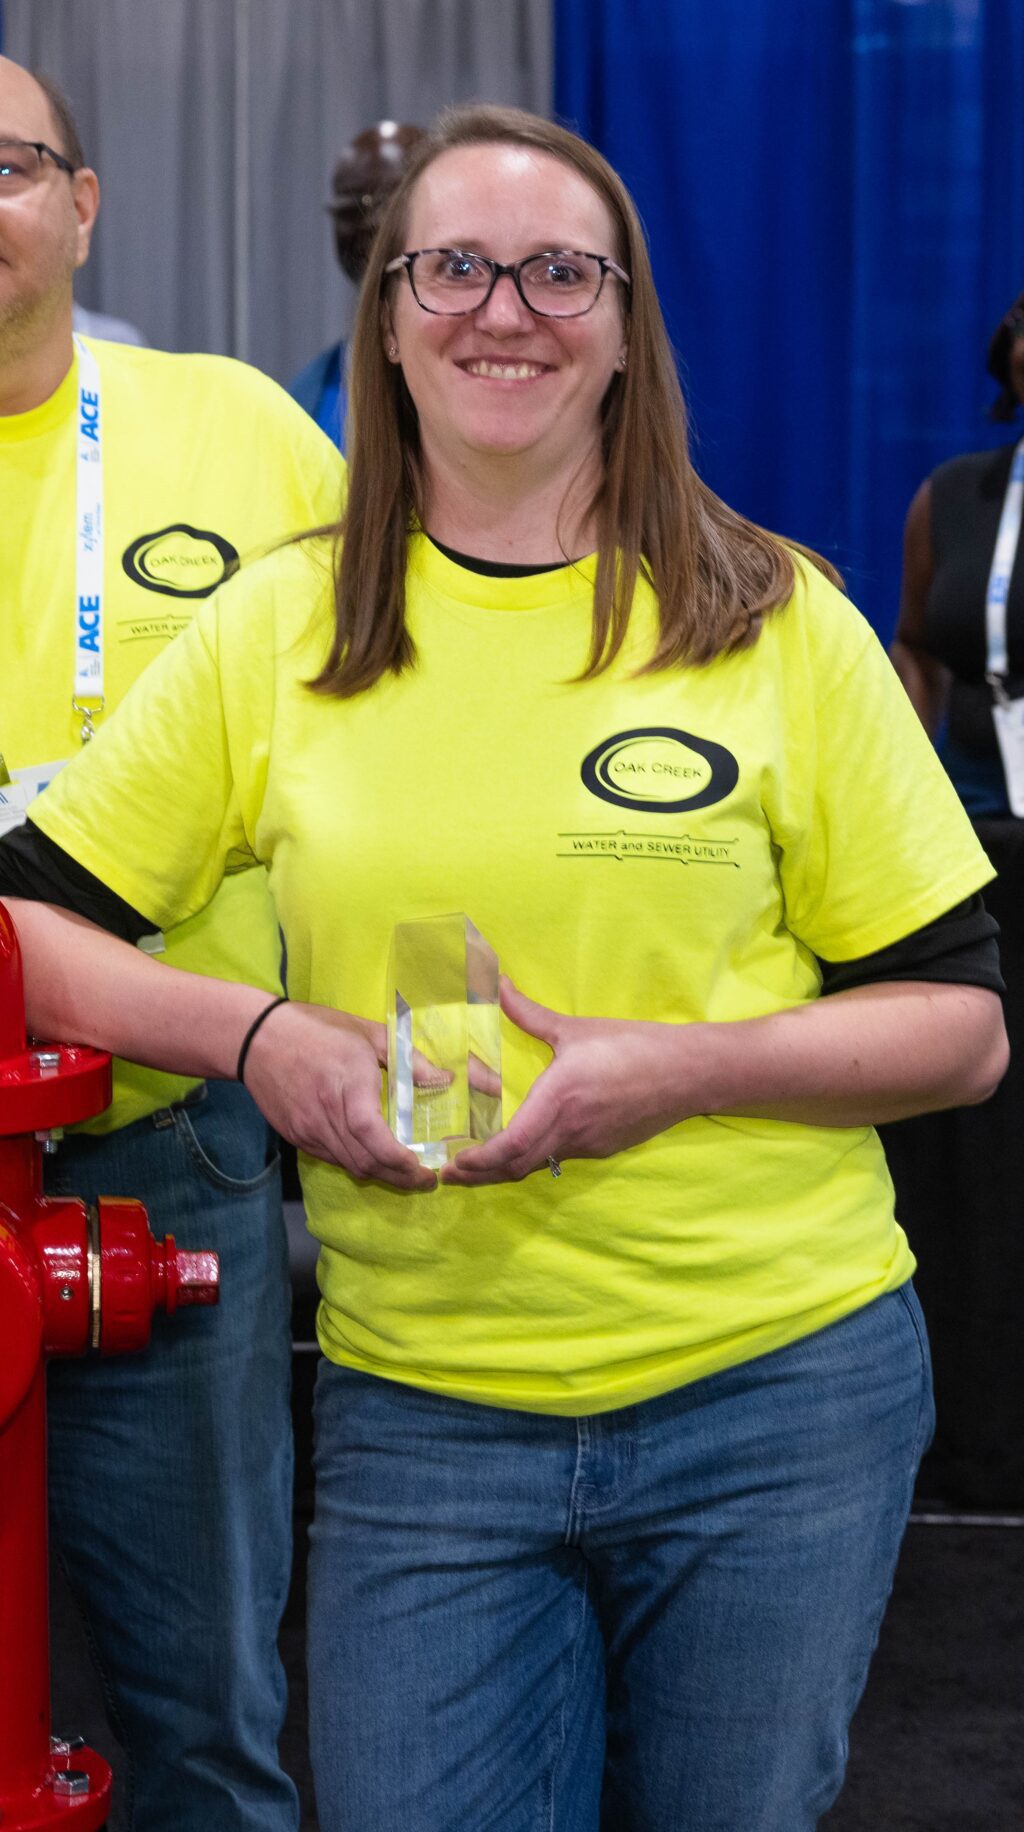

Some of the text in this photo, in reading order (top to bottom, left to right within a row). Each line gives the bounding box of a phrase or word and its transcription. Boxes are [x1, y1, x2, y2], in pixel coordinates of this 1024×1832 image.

[80, 387, 99, 442] ACE
[150, 555, 218, 567] OAK CREEK
[79, 595, 100, 653] ACE
[131, 623, 169, 634] WATER
[614, 761, 703, 778] OAK CREEK
[573, 839, 730, 857] WATER and SEWER UTILITY
